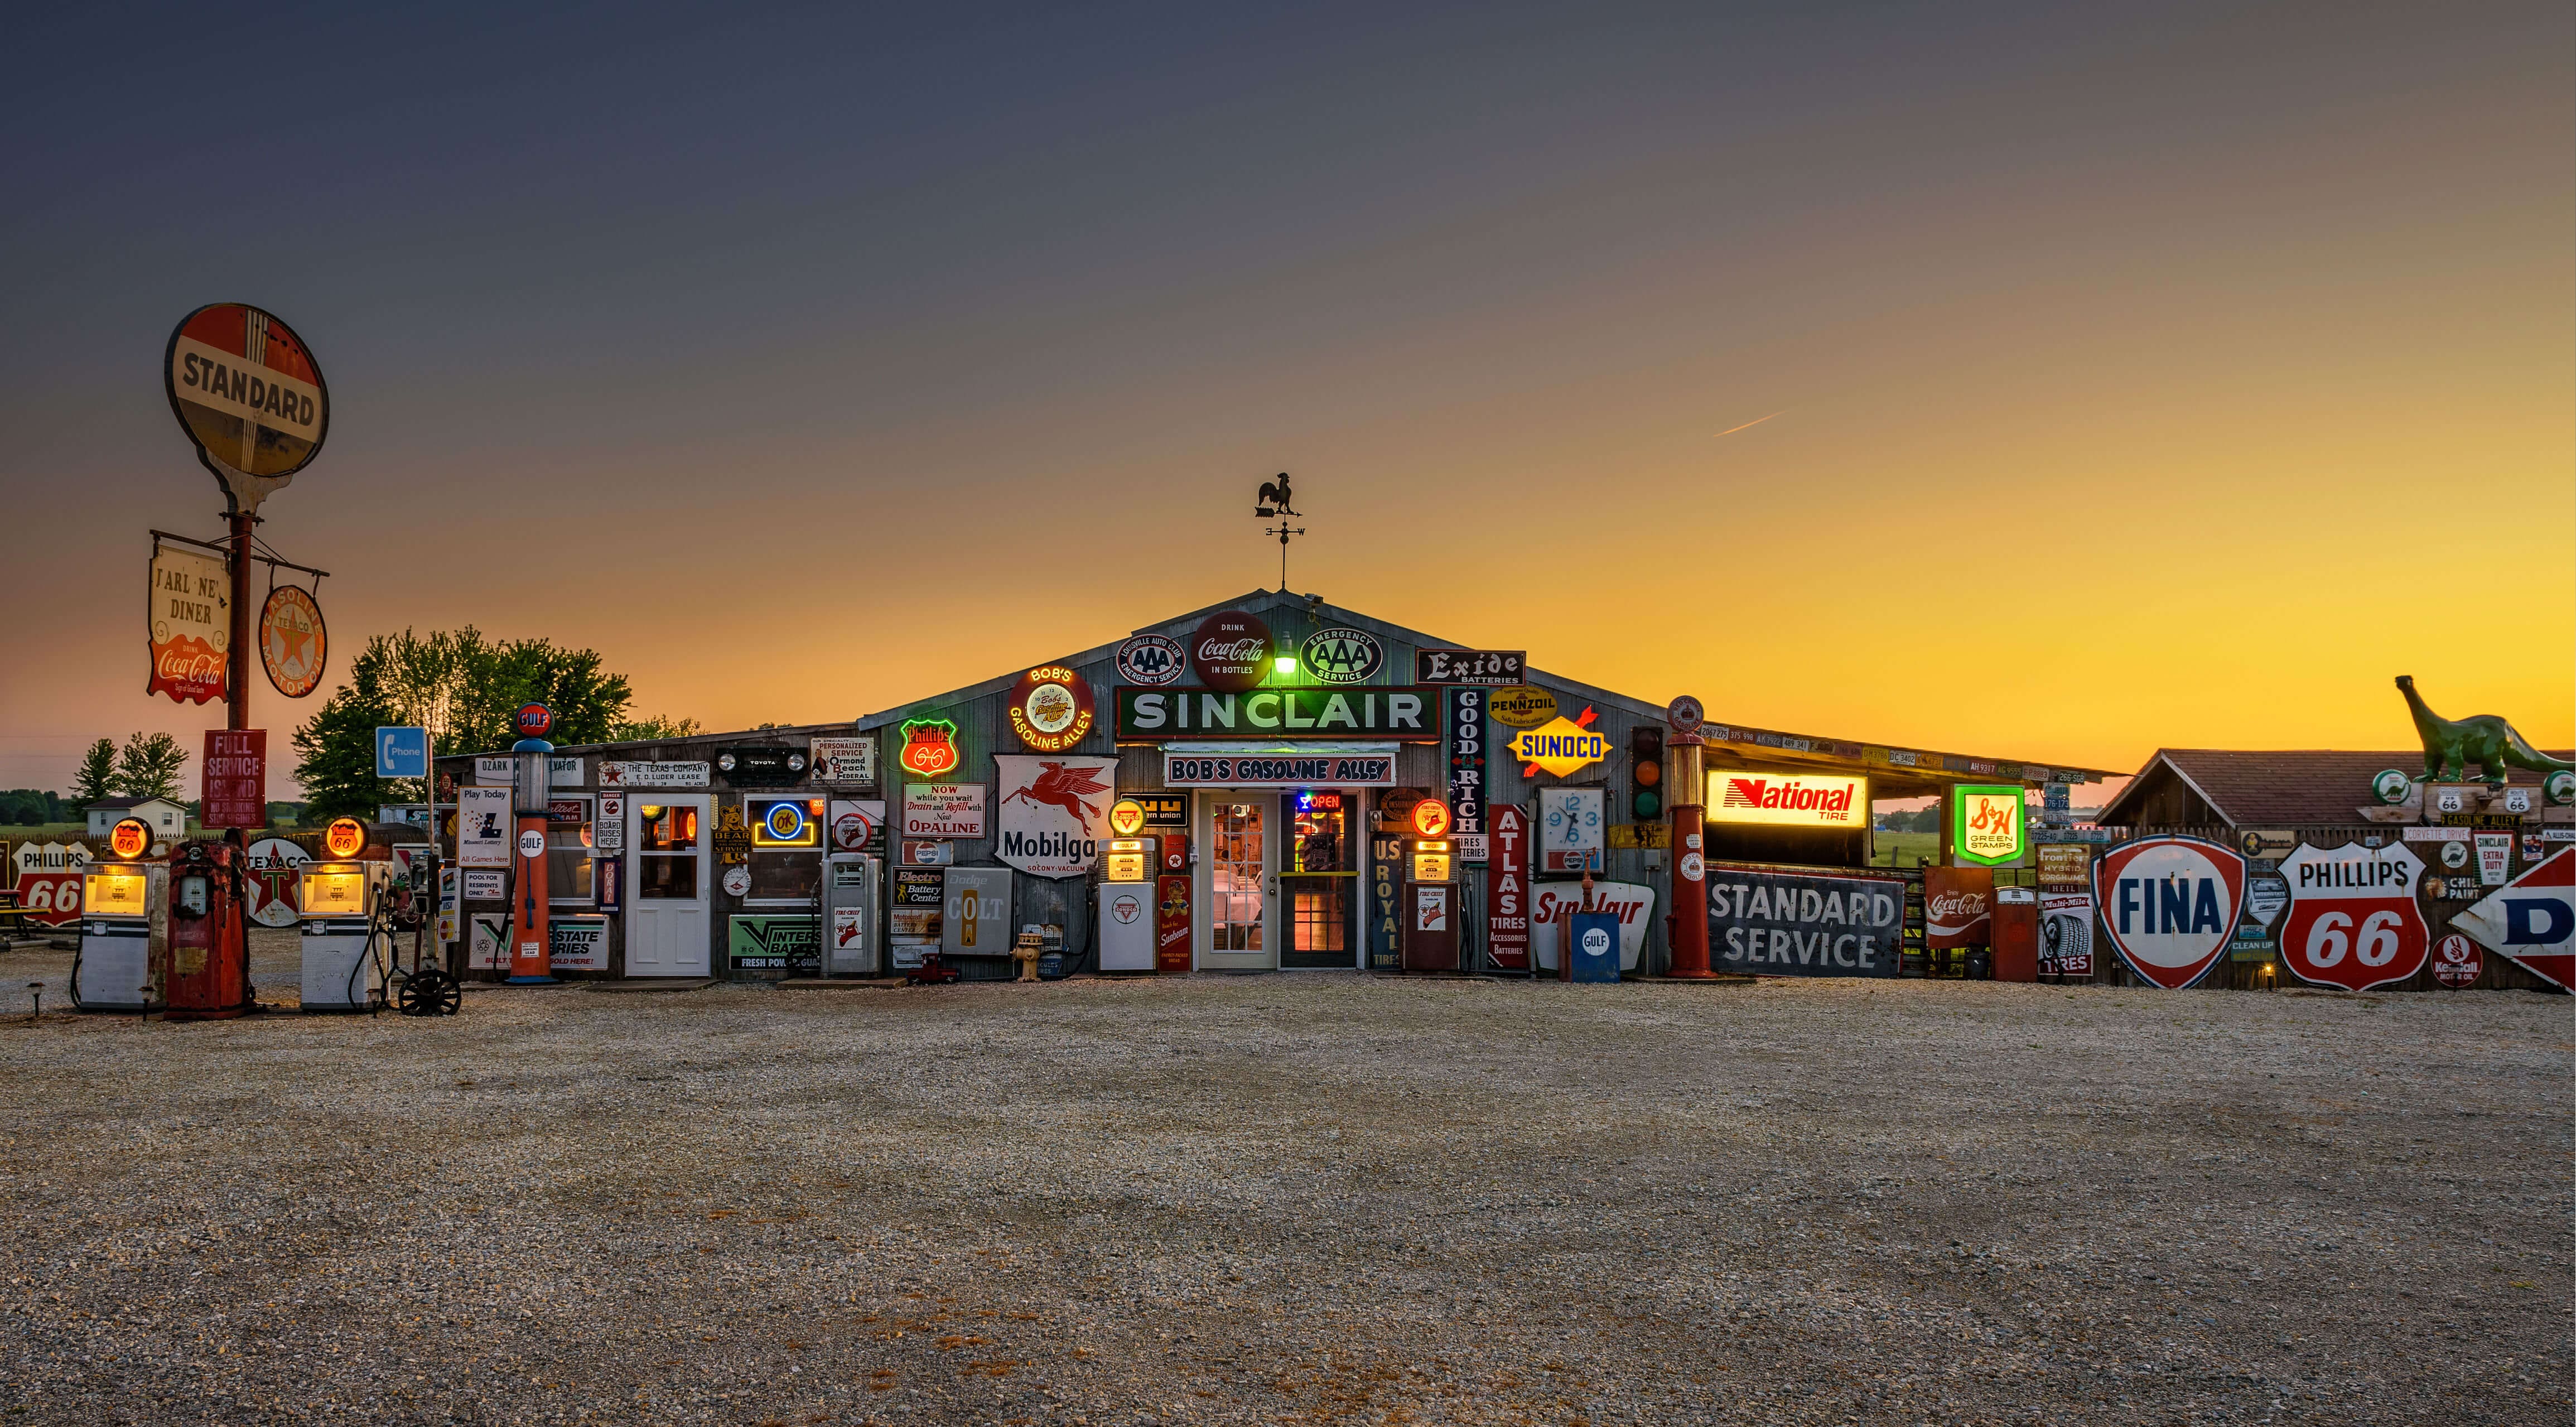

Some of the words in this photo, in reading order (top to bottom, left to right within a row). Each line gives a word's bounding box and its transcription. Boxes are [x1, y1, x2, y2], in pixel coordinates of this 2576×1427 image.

[183, 353, 314, 426] STANDARD
[170, 599, 211, 624] DINER
[264, 589, 323, 635] GASOLINE
[278, 617, 308, 632] TEXACO
[1309, 631, 1373, 647] EMERGENCY
[183, 645, 198, 653] DRINK
[1121, 637, 1150, 658] LOUISVILLE
[1151, 637, 1167, 646] AUTO
[1168, 643, 1181, 658] CLUB
[1198, 638, 1266, 662] Coca-Cola
[1133, 647, 1170, 673] AAA
[1314, 639, 1368, 671] AAA
[158, 649, 221, 685] Coca-Cola
[263, 644, 306, 694] MOTOR
[308, 654, 324, 683] OIL
[1427, 652, 1518, 679] Exide
[1031, 668, 1072, 682] BOB'S
[1121, 663, 1157, 683] EMERGENCY
[1159, 663, 1181, 681] SERVICE
[1317, 669, 1362, 681] SERVICE
[1041, 694, 1062, 704] Bob's
[1491, 698, 1555, 712] PENNZOIL
[1674, 701, 1683, 712] RED
[1684, 699, 1700, 712] CROWN
[1035, 702, 1068, 715] Gasoline
[1043, 710, 1066, 721] Alley
[1133, 693, 1422, 729] SINCLAIR
[519, 713, 548, 727] GULF
[1674, 716, 1700, 729] GASOLINE
[906, 726, 949, 743] Phillips
[1011, 707, 1060, 749] GASOLINE
[1063, 710, 1092, 746] ALLEY
[1718, 729, 1728, 739] 275
[215, 736, 252, 754] FULL
[392, 747, 420, 756] Phone
[1522, 735, 1601, 758] SUNOCO
[829, 756, 865, 766] Ormond
[914, 746, 946, 768] 66
[1900, 755, 1915, 763] 3402
[208, 758, 259, 777] SERVICE
[483, 760, 507, 771] OZARK
[628, 764, 641, 773] THE
[646, 764, 669, 773] TEXAS
[673, 764, 708, 773] COMPANY
[833, 764, 865, 773] Beach
[1171, 759, 1231, 780] BOB'S
[1236, 759, 1330, 780] GASOLINE
[1334, 759, 1390, 780] ALLEY
[1970, 762, 1979, 770] AH
[1980, 764, 1995, 772] 9317
[837, 771, 870, 780] FEDERAL
[464, 789, 480, 801] Play
[484, 789, 506, 800] Today
[1311, 796, 1339, 807] OPEN
[1723, 779, 1854, 812] National
[907, 802, 932, 811] Drain
[945, 802, 968, 813] Refill
[1566, 796, 1580, 811] 12
[2045, 799, 2069, 808] 176-173
[2443, 801, 2458, 809] 66
[2510, 801, 2525, 809] 66
[776, 814, 794, 830] OK
[934, 812, 952, 821] New
[1549, 812, 1561, 826] 9
[1585, 812, 1597, 827] 3
[1969, 798, 2014, 835] S&H
[2447, 815, 2485, 826] GASOLINE
[2490, 815, 2516, 826] ALLEY
[333, 826, 355, 836] Phillips
[909, 819, 979, 833] OPALINE
[601, 837, 619, 846] HERE
[1567, 828, 1579, 842] 6
[2408, 830, 2442, 840] CORVETTE
[2447, 830, 2466, 840] DRIVE
[118, 838, 134, 851] 66
[335, 837, 351, 849] 66
[484, 838, 501, 847] Lottery
[521, 837, 542, 849] GULF
[1004, 831, 1099, 865] Mobilga
[2477, 838, 2509, 847] SINCLAIR
[24, 853, 84, 867] PHILLIPS
[1682, 856, 1691, 865] RED
[2040, 848, 2083, 862] Frontier
[2483, 851, 2504, 860] EXTRA
[1498, 811, 1519, 914] ATLAS
[2485, 861, 2502, 870] DUTY
[897, 871, 942, 882] Electro
[949, 874, 987, 887] Dodge
[2299, 860, 2408, 888] PHILLIPS
[606, 864, 615, 902] DORAL
[908, 885, 942, 895] Battery
[28, 880, 81, 912] 66
[2044, 898, 2087, 908] Multi-Mile
[948, 897, 1004, 920] COLT
[1376, 865, 1399, 951] ROYAL
[1710, 883, 1894, 927] STANDARD
[1931, 893, 1986, 915] Coca-Cola
[2120, 878, 2223, 934] FINA
[1490, 917, 1526, 929] TIRES
[1160, 925, 1189, 947] Sunbeam
[1584, 936, 1606, 947] GULF
[2305, 910, 2403, 968] 66
[1723, 927, 1875, 968] SERVICE
[741, 958, 766, 967] FRESH
